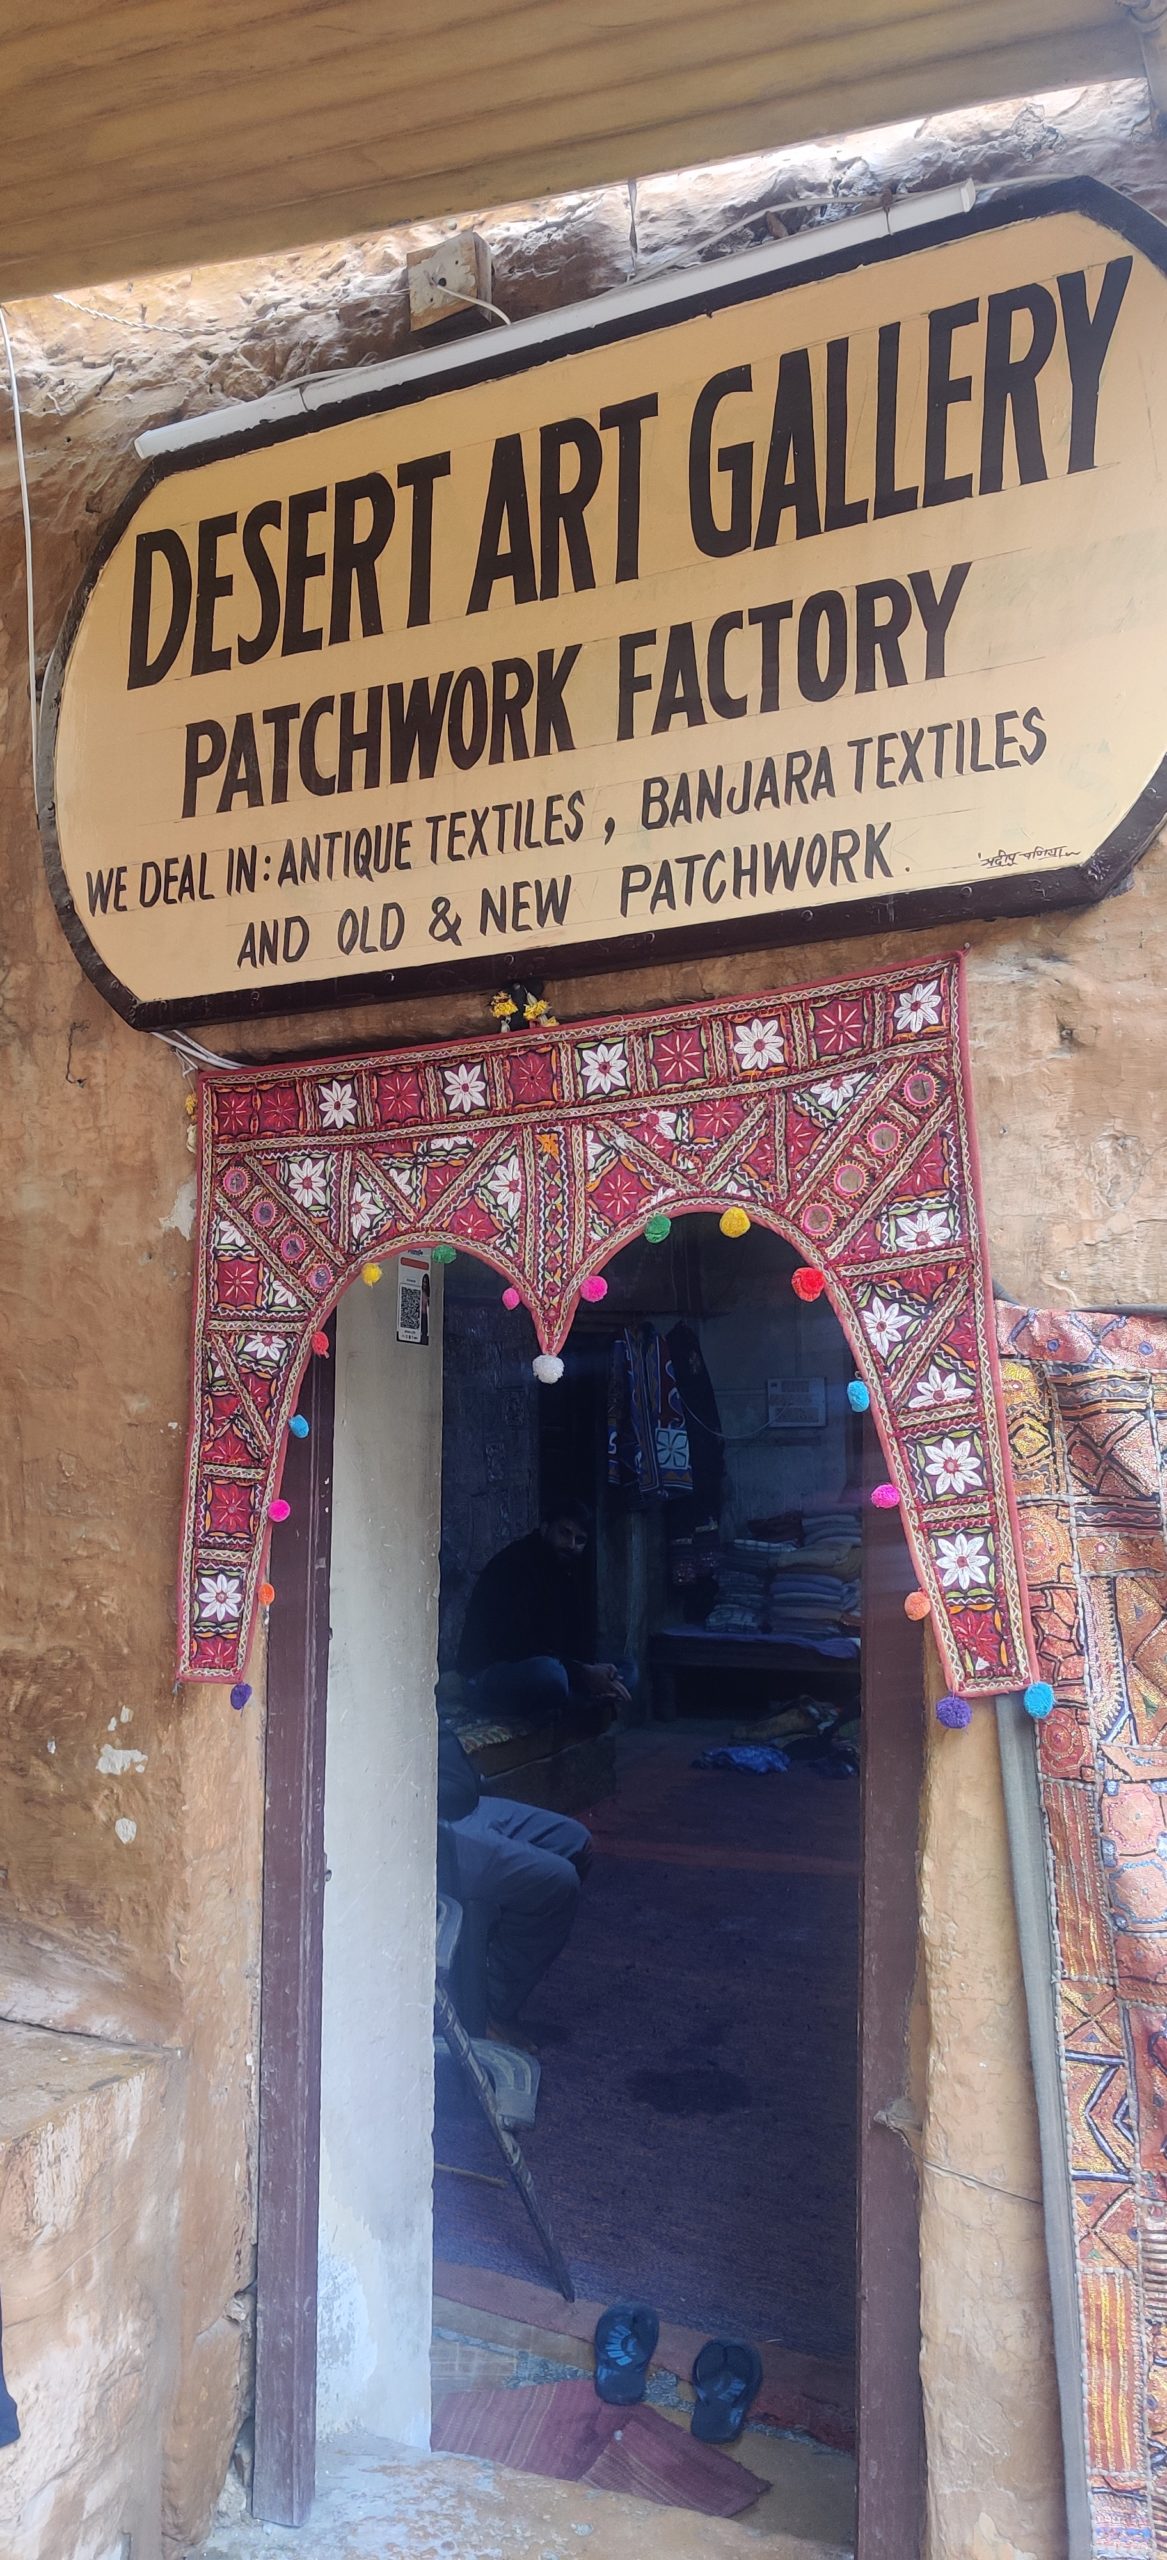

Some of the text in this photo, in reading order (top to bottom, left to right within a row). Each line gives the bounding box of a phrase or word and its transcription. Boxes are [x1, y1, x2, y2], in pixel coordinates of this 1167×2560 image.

[127, 254, 1135, 692] DESERT ART GALLERY
[181, 560, 974, 819] PATCHWORK FACTORY
[85, 864, 130, 918] WE
[139, 850, 217, 908] DEAL
[277, 818, 415, 888] ANTIQUE
[425, 789, 586, 866] TEXTILES
[641, 744, 837, 831] BANJARA
[848, 706, 1048, 794] TEXTILES
[236, 915, 310, 969] AND
[337, 900, 405, 956] OLD
[428, 895, 463, 948] &
[479, 873, 573, 938] NEW
